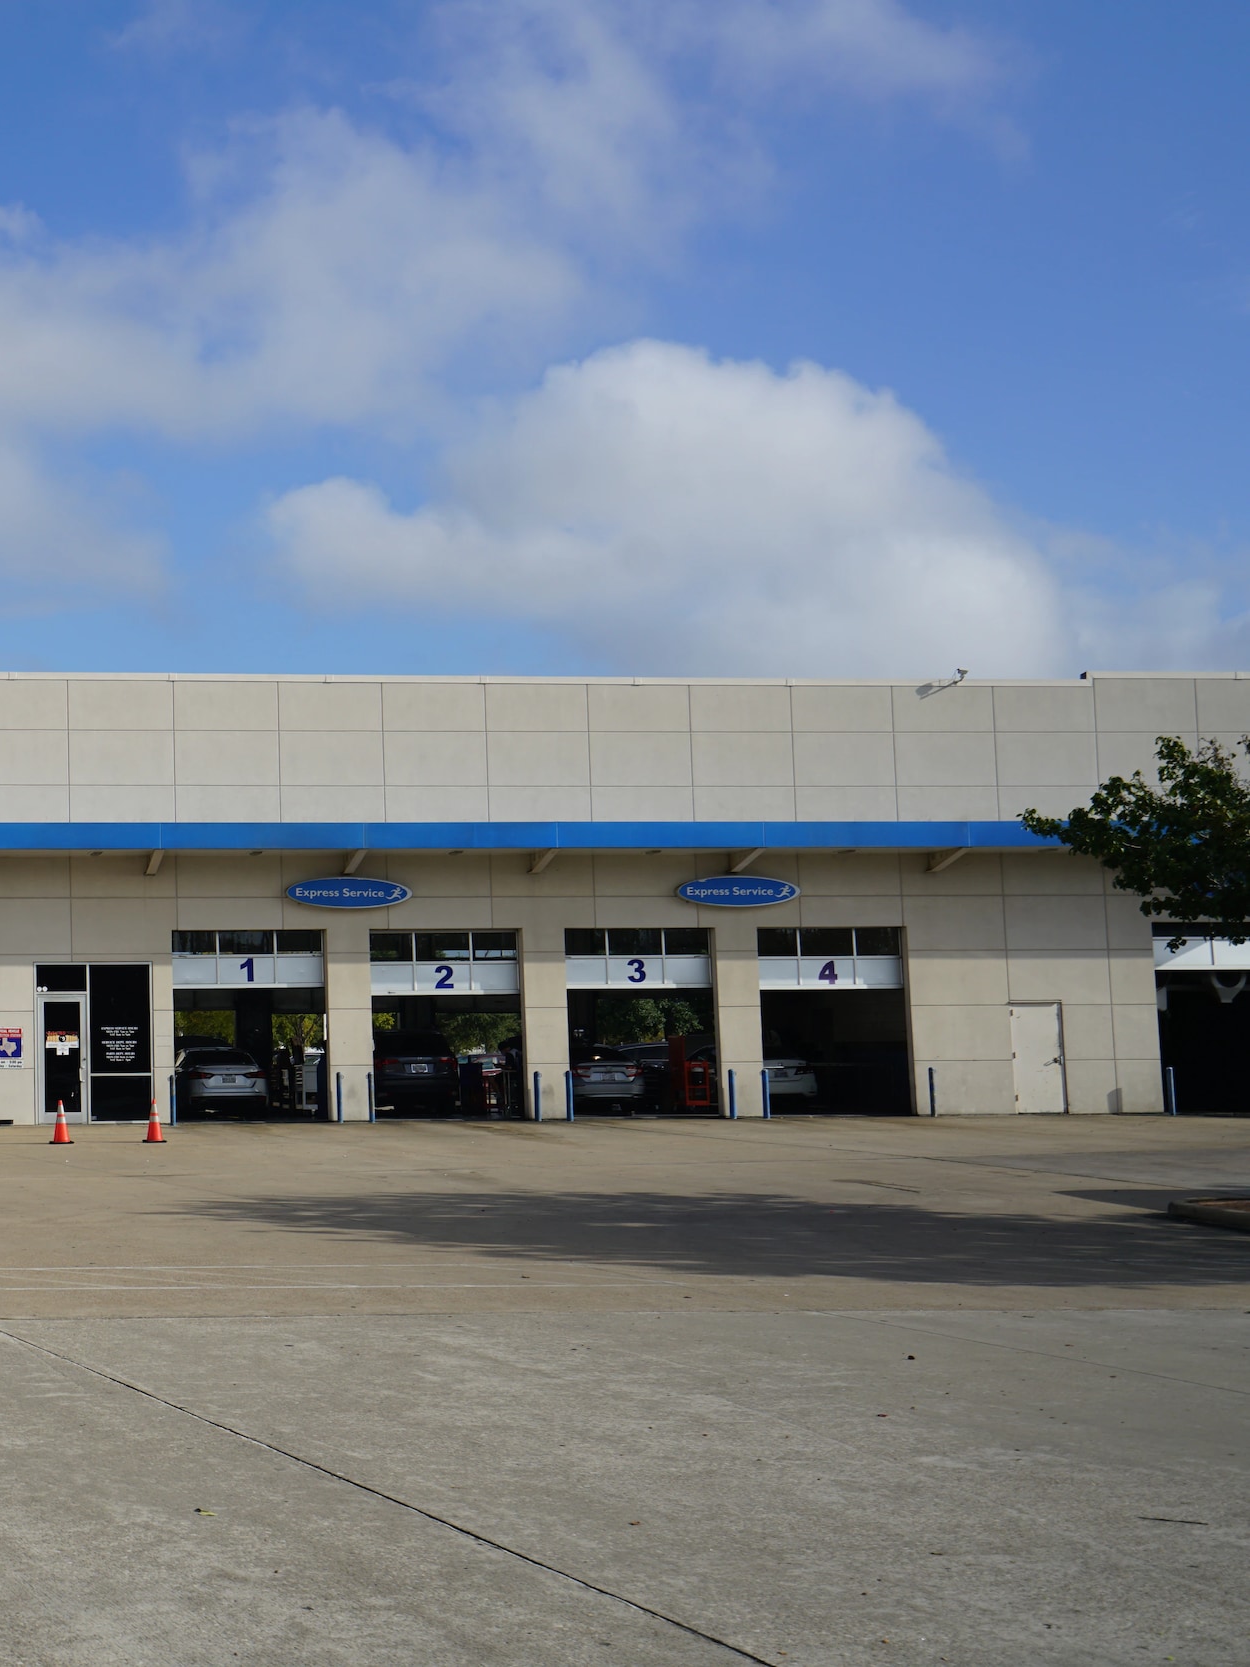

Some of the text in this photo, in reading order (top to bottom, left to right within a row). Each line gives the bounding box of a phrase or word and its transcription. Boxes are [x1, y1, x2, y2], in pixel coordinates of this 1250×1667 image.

[295, 887, 385, 898] Express Service
[686, 886, 774, 897] Express Service
[240, 958, 254, 982] 1
[435, 965, 454, 989] 2
[627, 959, 646, 983] 3
[818, 960, 838, 985] 4
